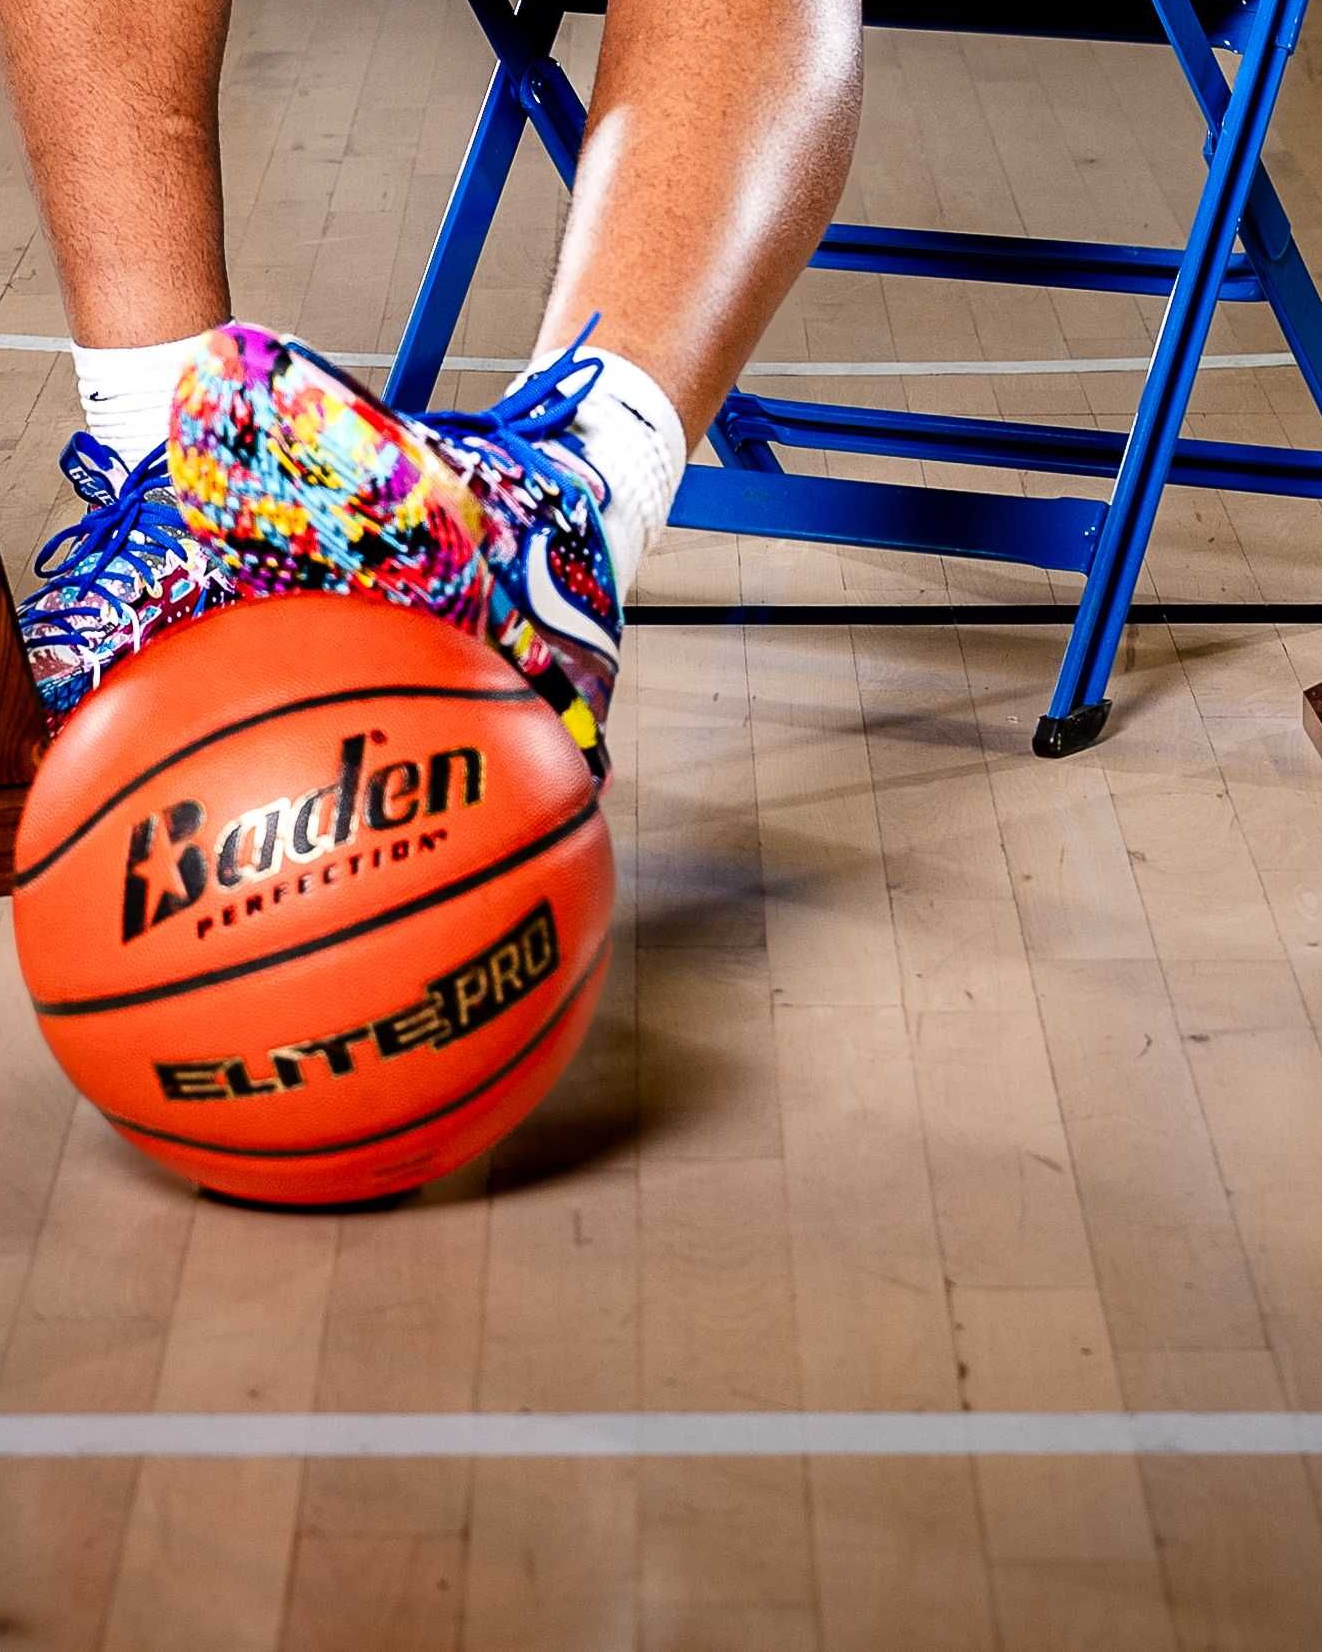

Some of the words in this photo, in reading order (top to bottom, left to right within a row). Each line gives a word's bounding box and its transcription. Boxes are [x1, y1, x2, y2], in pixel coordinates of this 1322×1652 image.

[122, 730, 487, 945] Baden
[153, 995, 453, 1102] ELITE
[453, 915, 555, 1029] PRO
